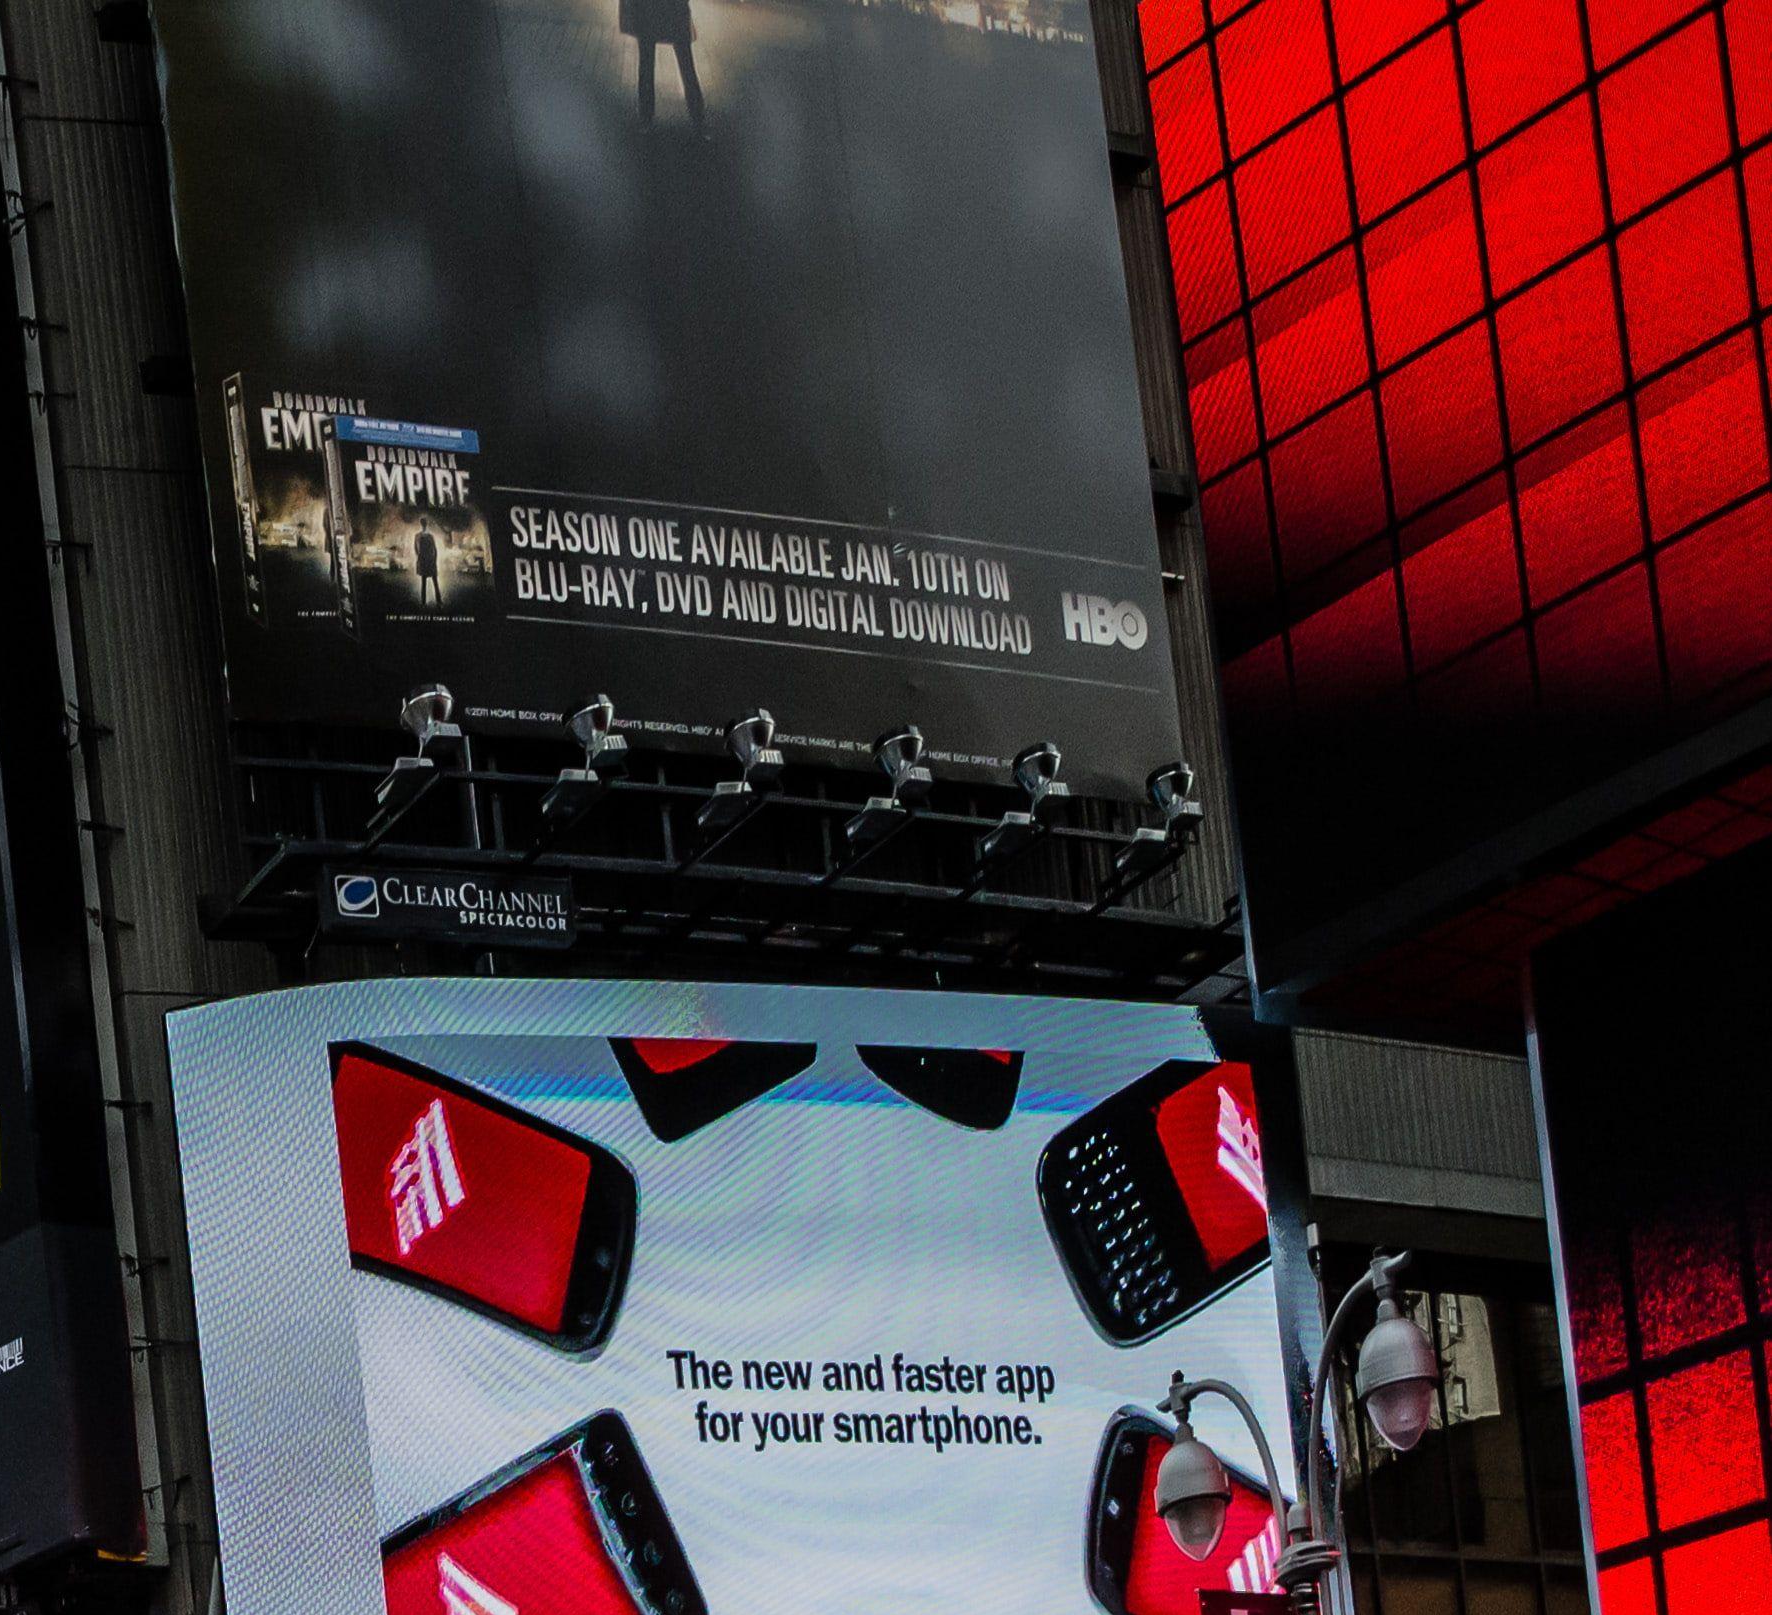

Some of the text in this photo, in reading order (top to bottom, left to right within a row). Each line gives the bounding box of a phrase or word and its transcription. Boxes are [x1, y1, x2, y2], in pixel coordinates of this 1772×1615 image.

[354, 460, 470, 506] EMPIRE
[367, 445, 457, 470] BOARDWALK
[509, 505, 1011, 603] SEASON ONE AVAILABLE JAN. 10TH ON
[656, 571, 1033, 656] DVD AND DIGITAL DOWNLOAD
[1061, 590, 1149, 651] HBO
[459, 910, 567, 931] SPECTACOLOR
[666, 1350, 1055, 1403] The new and faster app
[695, 1400, 1042, 1453] for your smartphone.
